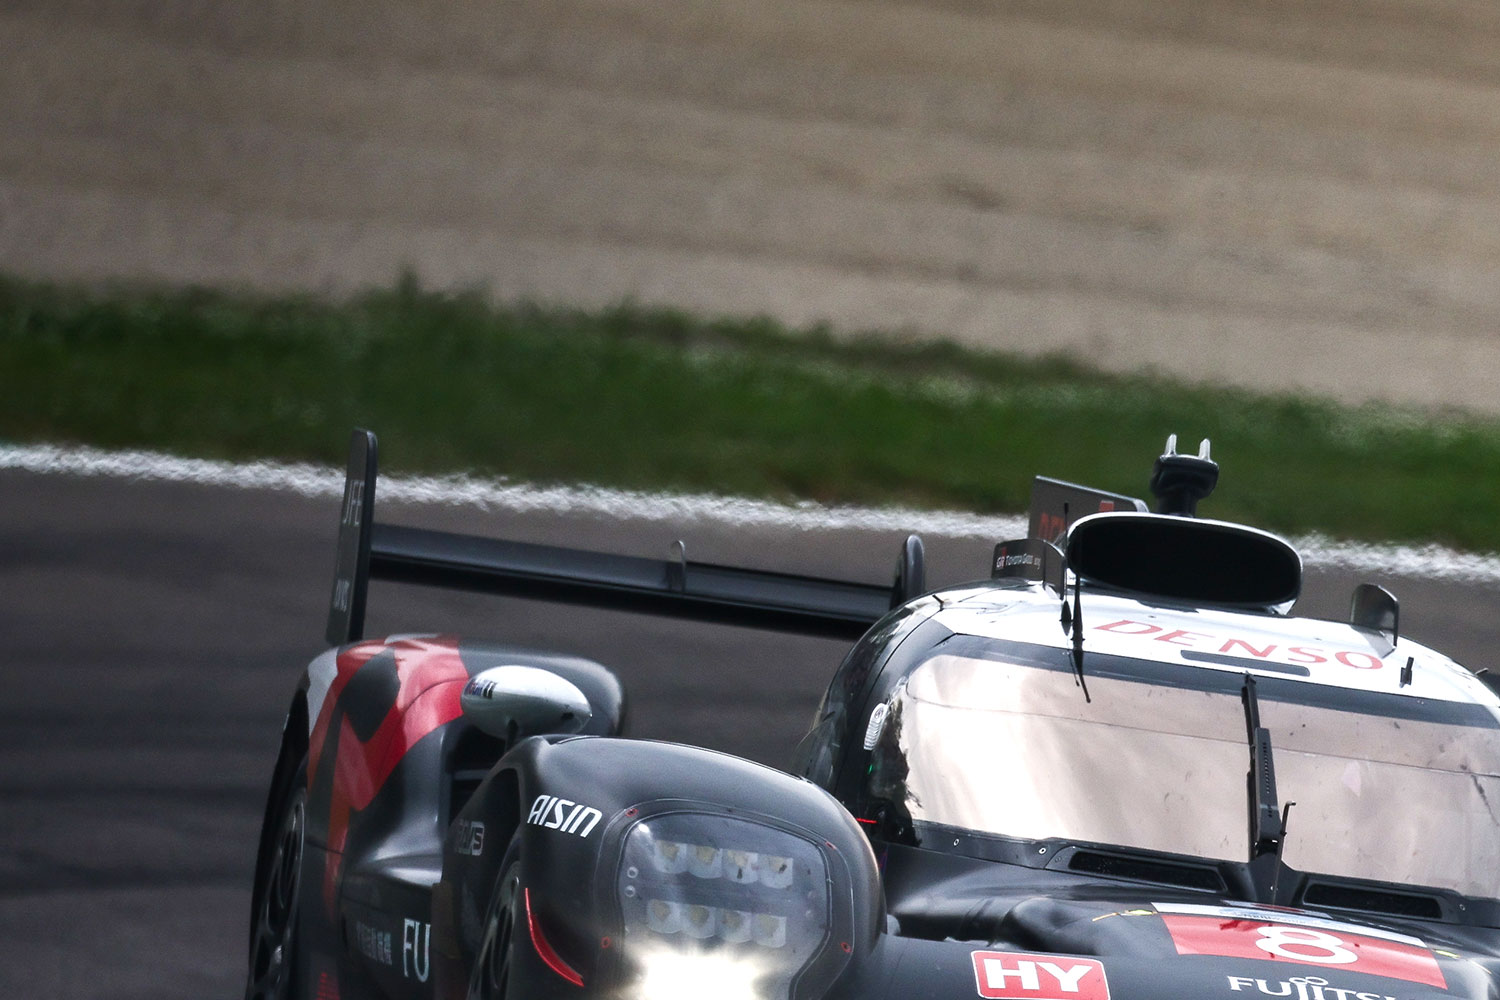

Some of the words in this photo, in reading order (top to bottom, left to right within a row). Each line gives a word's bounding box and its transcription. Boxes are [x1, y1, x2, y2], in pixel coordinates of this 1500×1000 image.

[1093, 619, 1384, 670] DENSO
[527, 794, 603, 838] AISIN
[1255, 916, 1359, 964] 8
[983, 958, 1093, 993] HY
